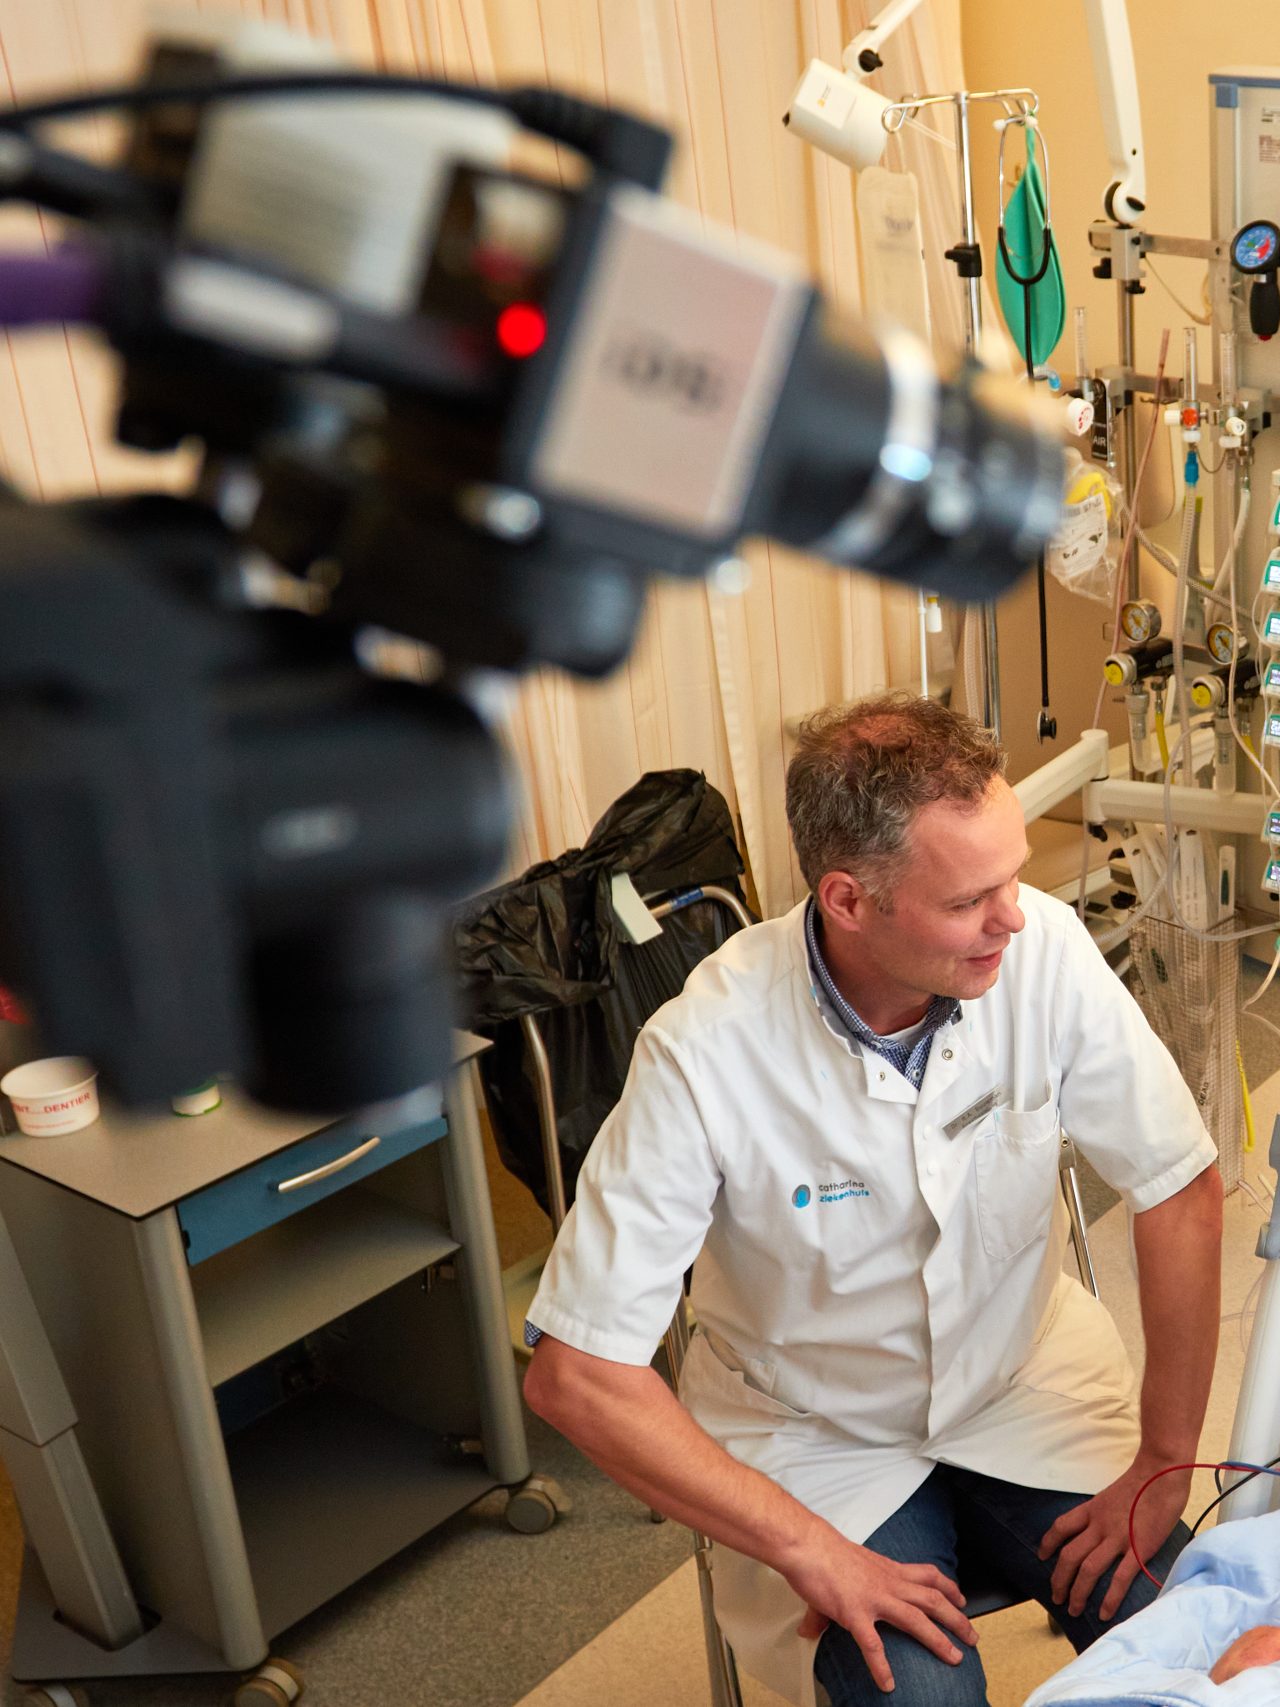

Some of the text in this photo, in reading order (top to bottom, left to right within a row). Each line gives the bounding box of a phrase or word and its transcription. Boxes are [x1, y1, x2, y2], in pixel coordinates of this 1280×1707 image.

[1093, 435, 1106, 447] AIR
[43, 1092, 91, 1113] DENTIER
[819, 1179, 865, 1192] catharina
[819, 1189, 870, 1203] ziekenhuis
